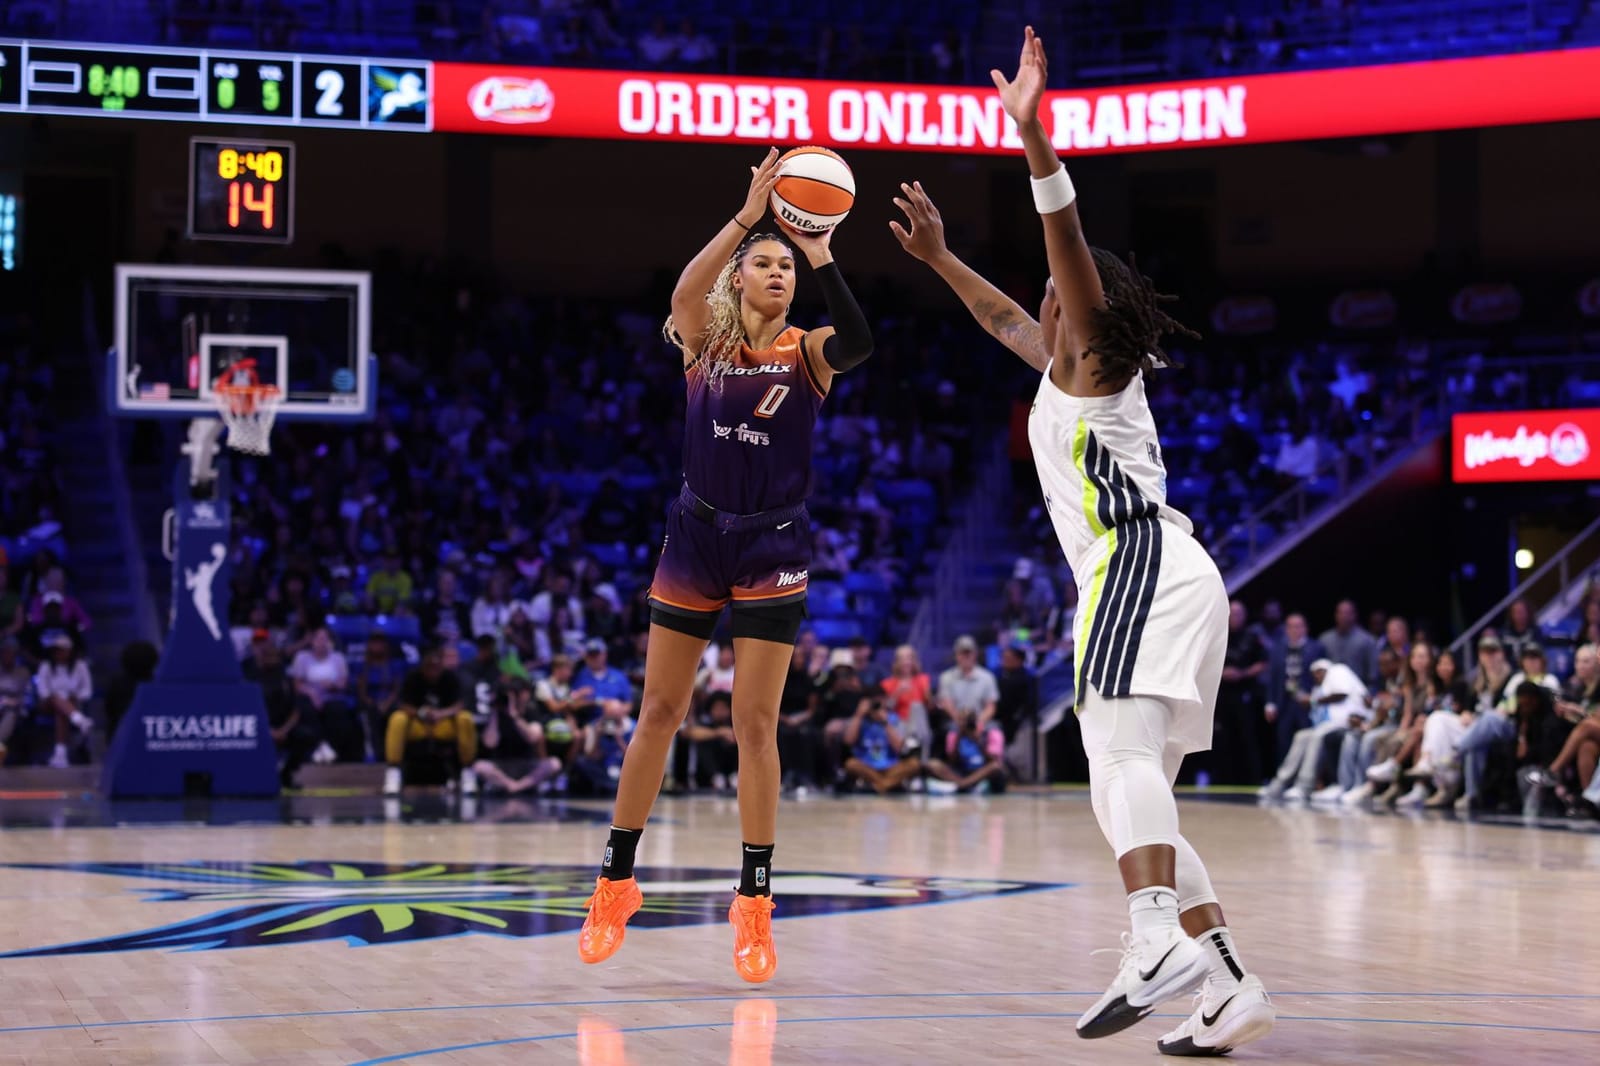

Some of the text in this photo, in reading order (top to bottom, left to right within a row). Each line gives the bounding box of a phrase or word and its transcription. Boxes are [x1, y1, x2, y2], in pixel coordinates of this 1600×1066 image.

[262, 79, 280, 111] 5
[315, 70, 344, 116] 2
[619, 79, 812, 139] ORDER
[1051, 85, 1247, 150] RAISIN
[218, 149, 283, 181] 8:40
[228, 181, 274, 229] 14
[781, 205, 836, 230] Wilson
[710, 360, 792, 376] Phoenix
[753, 384, 791, 418] 0
[735, 423, 770, 446] fry's
